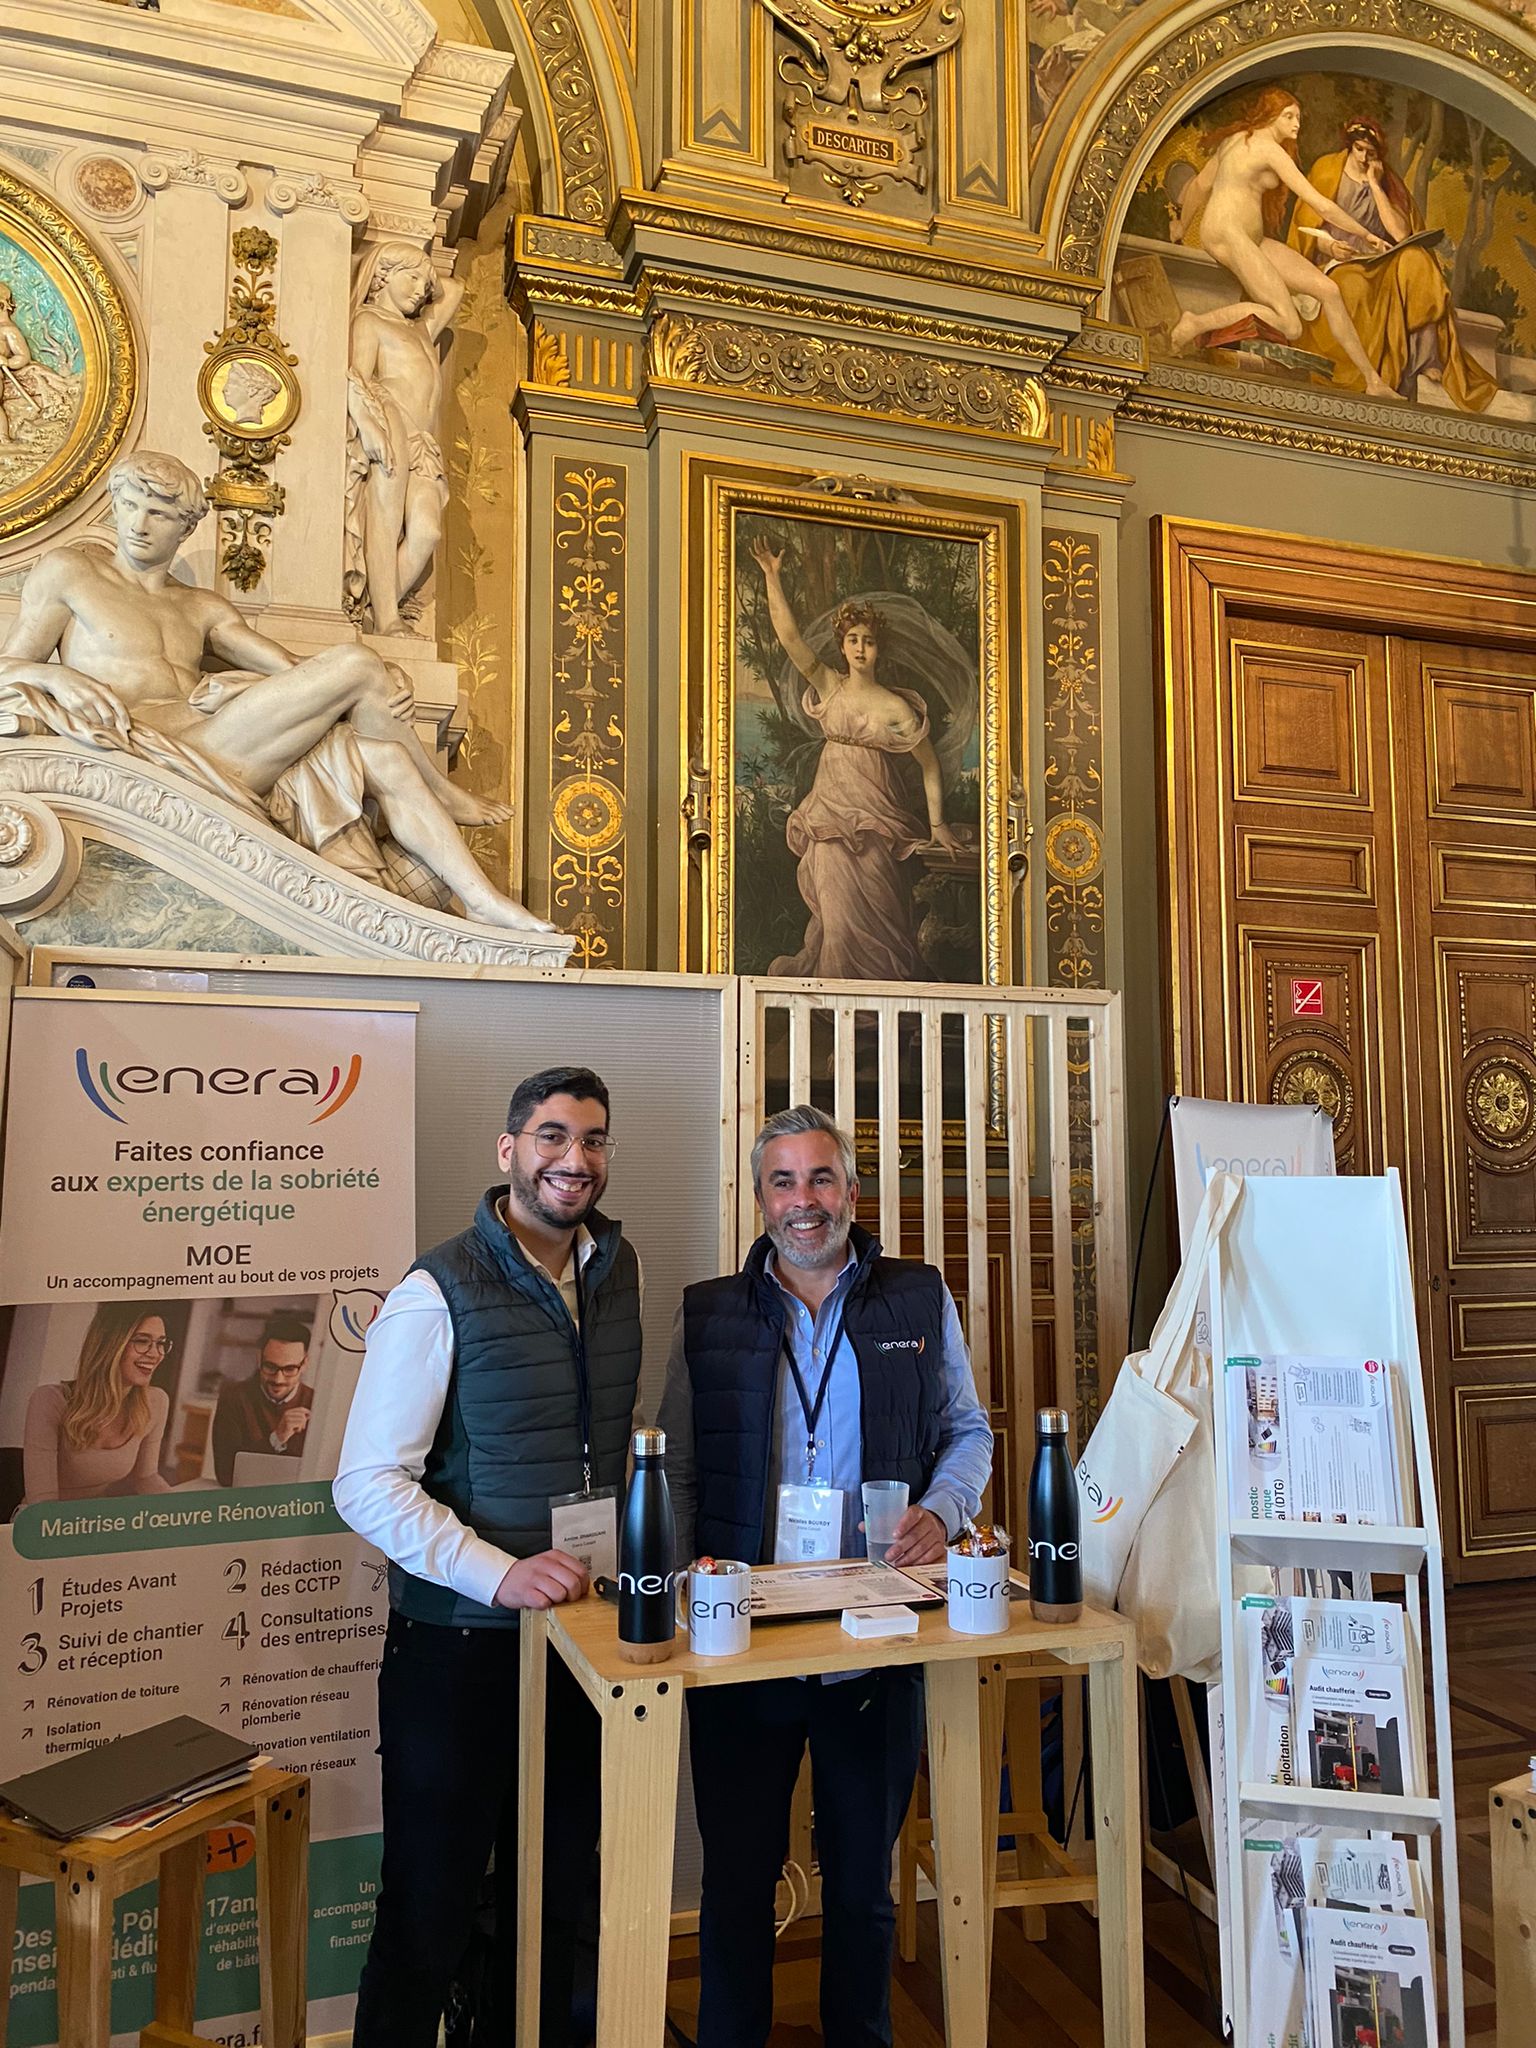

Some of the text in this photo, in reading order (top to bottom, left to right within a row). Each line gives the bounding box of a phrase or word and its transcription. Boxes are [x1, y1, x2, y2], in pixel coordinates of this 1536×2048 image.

[817, 129, 889, 158] DESCARTES
[114, 1140, 324, 1161] Faites confiance
[51, 1168, 380, 1197] aux experts de la sobriété
[142, 1200, 295, 1227] énergétique
[186, 1245, 252, 1266] MOE
[47, 1266, 379, 1290] Un accompagnement au bout de vos projets
[1248, 1486, 1259, 1519] nostic
[1261, 1489, 1273, 1519] nique
[1273, 1478, 1286, 1508] (DTG)
[41, 1514, 126, 1537] Maitrise
[217, 1498, 325, 1522] Rénovation
[223, 1558, 247, 1593] 2
[261, 1559, 342, 1578] Rédaction
[27, 1577, 44, 1616] 1
[62, 1572, 177, 1597] Études Avant
[261, 1576, 341, 1597] des CCTP
[61, 1599, 123, 1618] Projets
[261, 1605, 373, 1628] Consultations
[58, 1622, 204, 1650] Suivi de chantier
[221, 1611, 250, 1650] 4
[261, 1623, 386, 1648] des entreprises
[17, 1632, 48, 1676] 3
[57, 1647, 163, 1671] et réception
[243, 1669, 308, 1685] Rénovation
[311, 1666, 325, 1677] de
[46, 1684, 180, 1709] Rénovation de toiture
[242, 1690, 350, 1712] Rénovation réseau
[46, 1721, 101, 1737] Isolation
[242, 1710, 301, 1729] plomberie
[311, 1728, 371, 1744] ventilation
[311, 1757, 357, 1772] réseaux
[1278, 1725, 1294, 1786] xploitation
[359, 1881, 376, 1893] Un
[207, 1896, 258, 1917] 17an
[351, 1918, 370, 1929] sur
[129, 1964, 138, 1977] &
[216, 1957, 232, 1971] de
